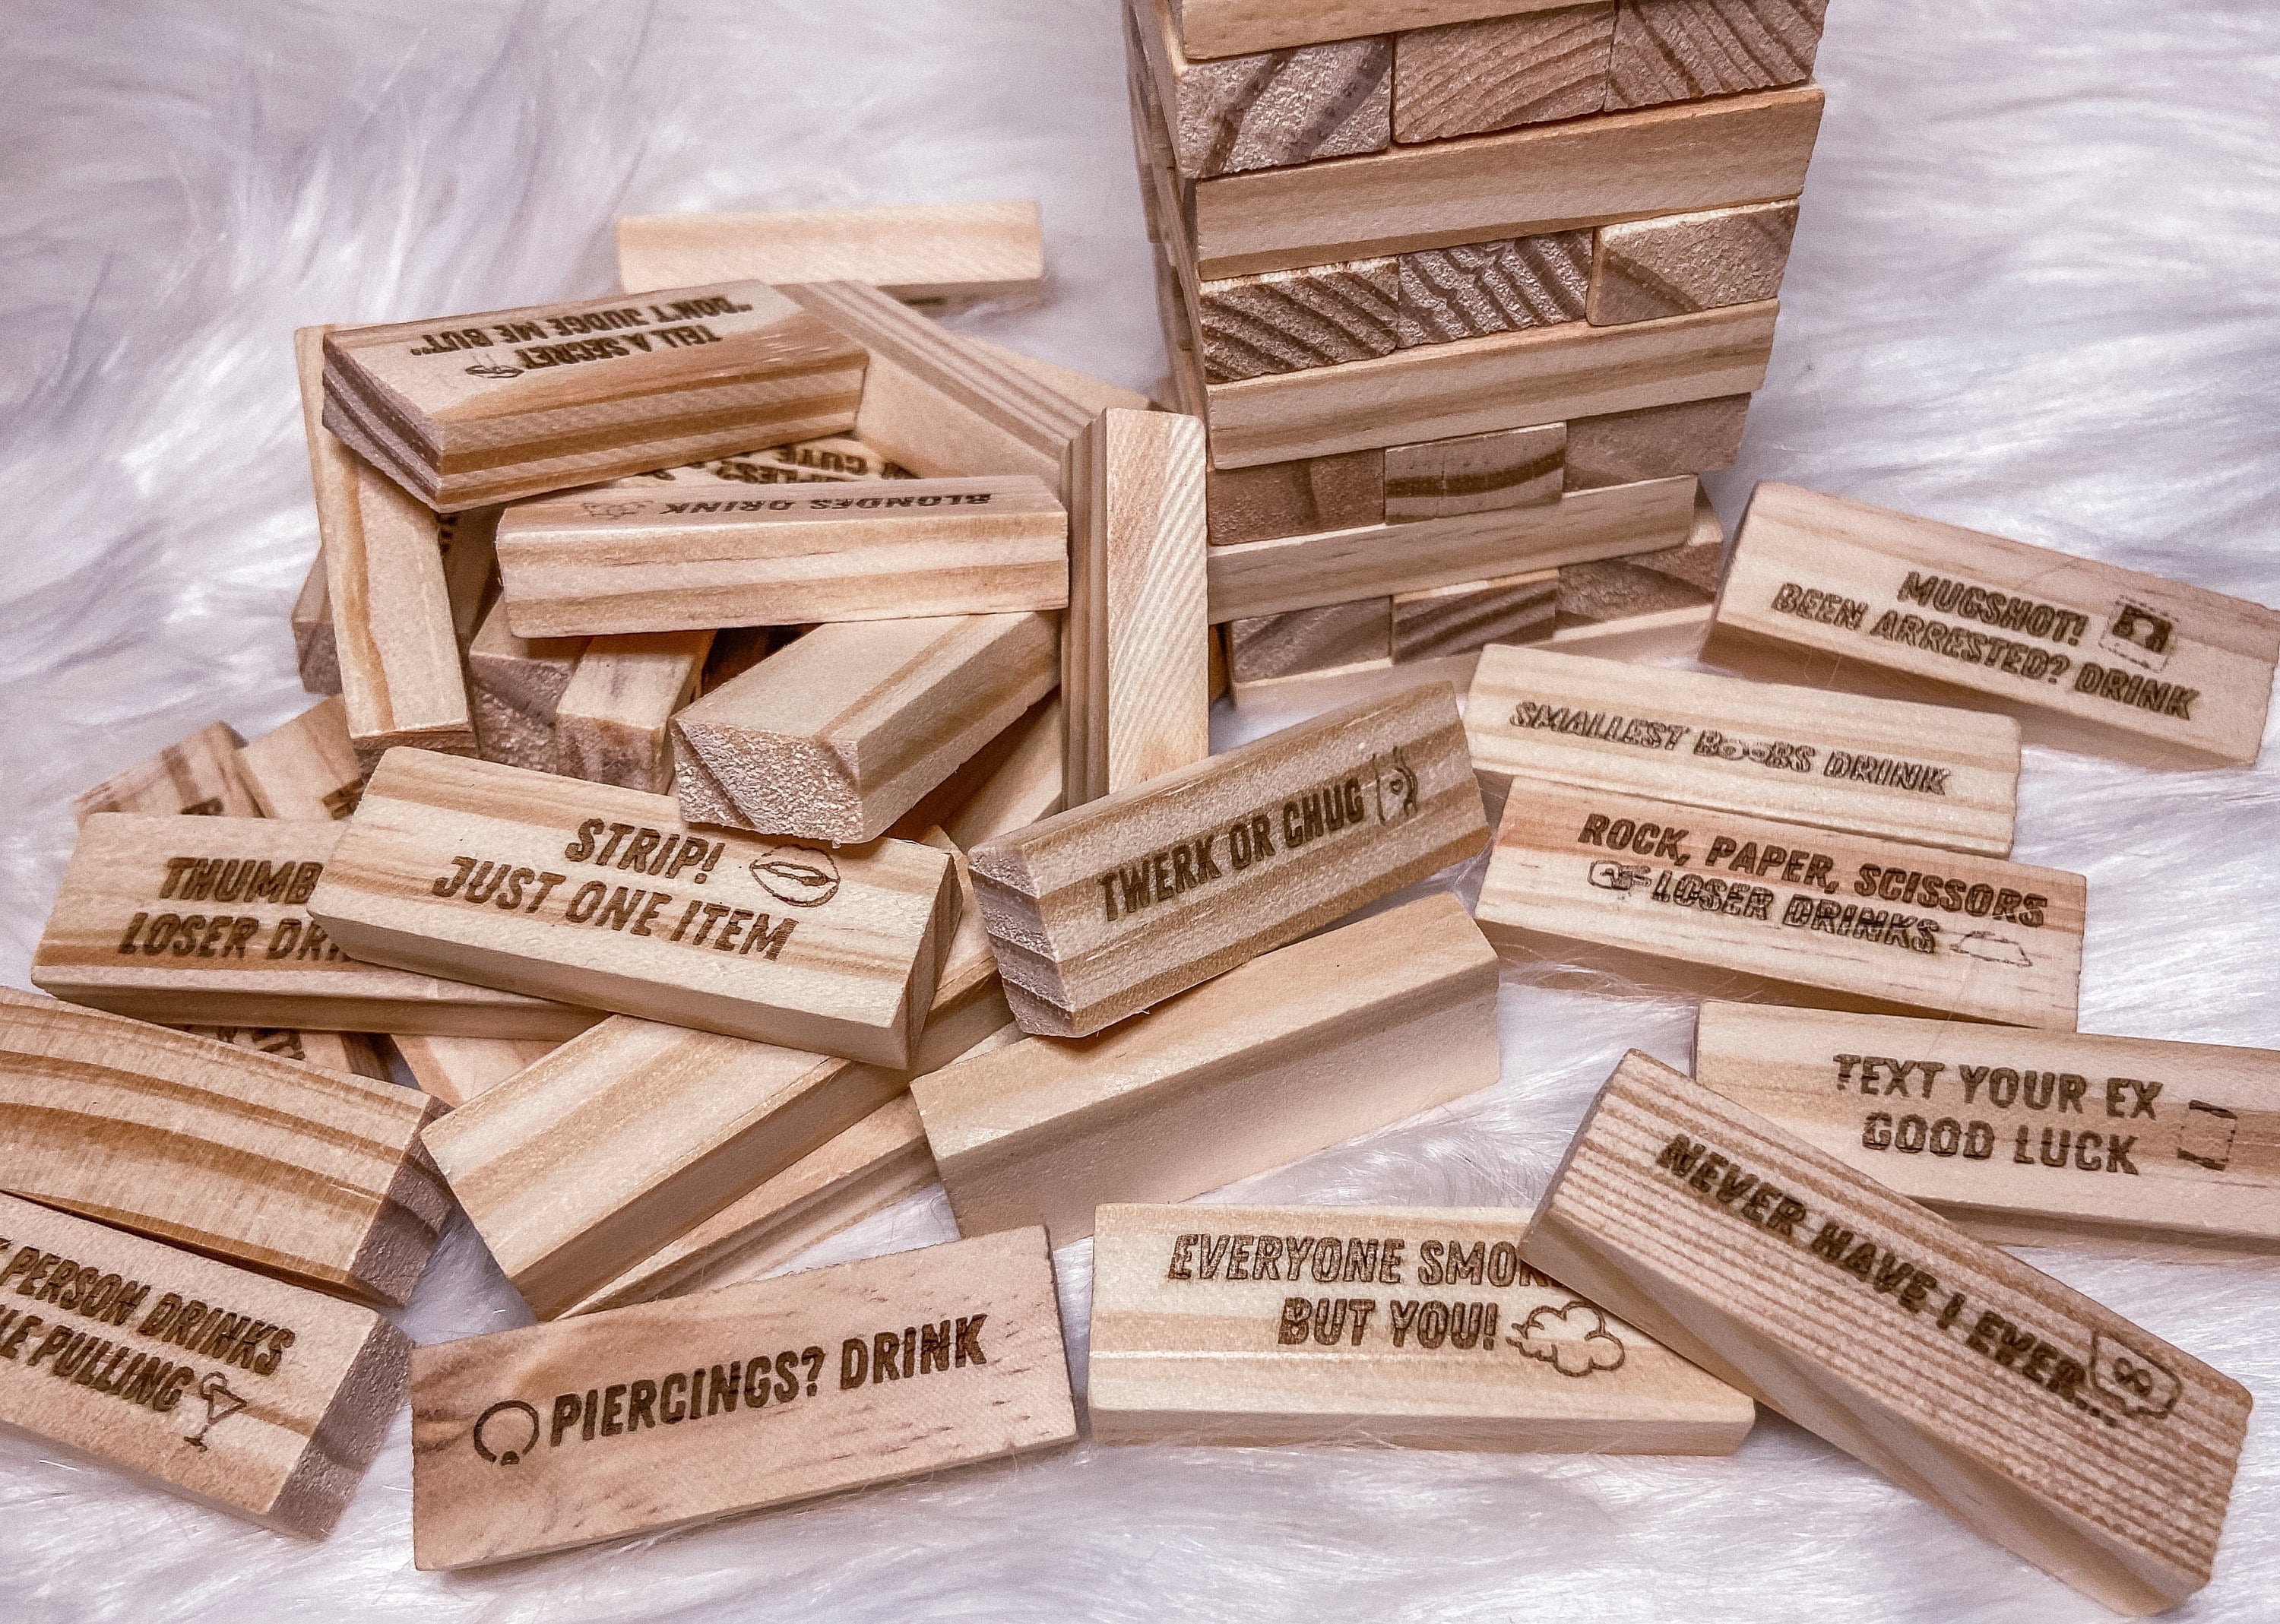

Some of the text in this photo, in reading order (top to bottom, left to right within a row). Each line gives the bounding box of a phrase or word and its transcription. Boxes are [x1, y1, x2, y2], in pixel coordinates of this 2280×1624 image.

[493, 322, 549, 343] ME
[514, 324, 724, 369] TELL A SECRET
[546, 311, 644, 336] JUDGE
[660, 493, 992, 516] BLONDES DRINK
[1896, 571, 2088, 646] MUGSHOT!
[1770, 582, 2200, 720] BEEN ARRESTED? DRINK
[1509, 701, 1689, 751] SMALLEST
[1823, 749, 1951, 796] DRINK
[159, 856, 325, 904] THUMB
[565, 817, 726, 884] STRIP!
[1098, 777, 1364, 921] TWERK OR CHUG
[1577, 813, 2048, 928] ROCK, PAPER, SCISSORS
[117, 912, 259, 958] LOSER
[432, 856, 800, 961] JUST ONE ITEM
[1651, 869, 1940, 954] LOSER DRINKS
[1832, 1053, 2164, 1121] TEXT YOUR EX
[1861, 1111, 2140, 1176] GOOD LUCK
[1168, 1233, 1405, 1284] EVERYONE
[1655, 1133, 1807, 1236] NEVER
[1811, 1219, 1938, 1314] HAVE
[1936, 1291, 1967, 1331] I
[0, 1246, 152, 1326] PERSON
[138, 1293, 296, 1376] DRINKS
[1278, 1296, 1499, 1350] BUT YOU!
[27, 1325, 195, 1412] PULLING
[549, 1314, 988, 1447] PIERCINGS? DRINK
